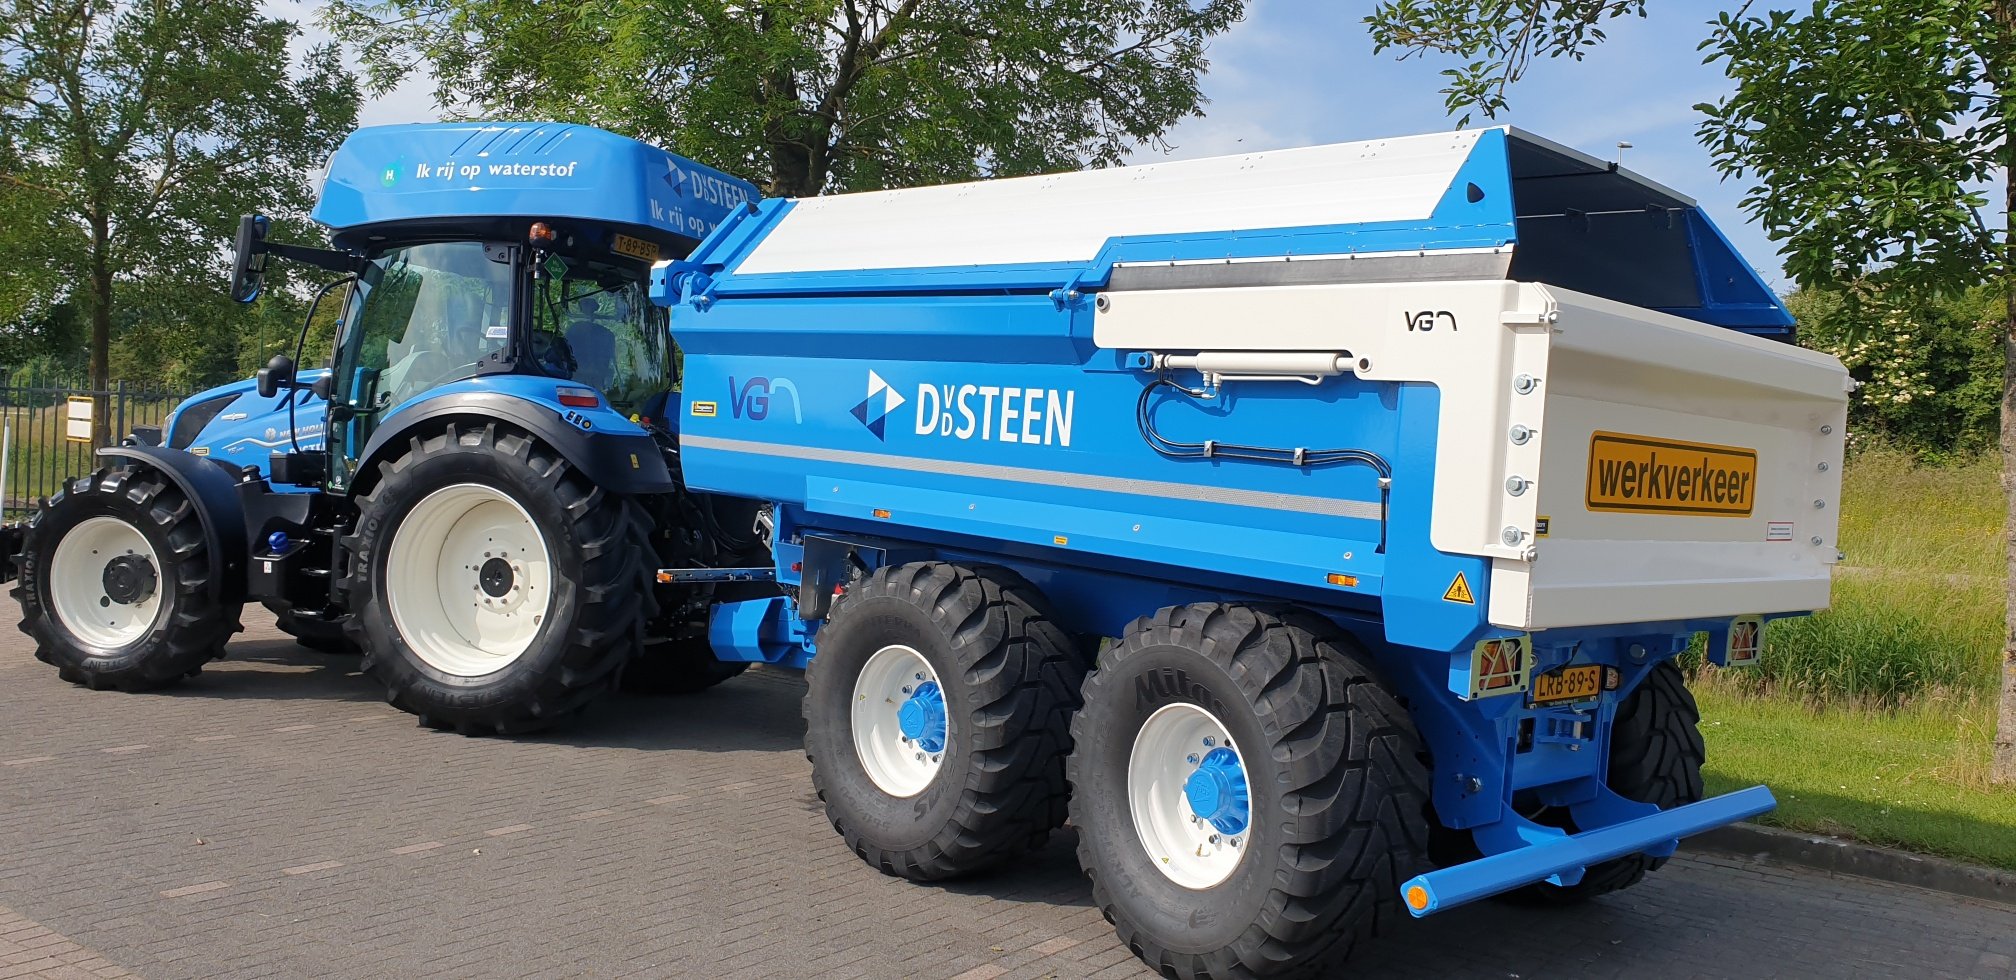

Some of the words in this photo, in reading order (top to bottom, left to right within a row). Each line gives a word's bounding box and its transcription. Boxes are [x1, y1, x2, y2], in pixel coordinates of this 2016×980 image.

[416, 163, 431, 178] Ik
[436, 161, 455, 181] rij
[460, 164, 480, 180] op
[489, 162, 577, 177] waterstof
[651, 199, 664, 221] Ik
[669, 206, 684, 232] rij
[689, 216, 704, 237] op
[1599, 451, 1749, 504] werkverkeer
[1538, 669, 1596, 697] LRB-89-S
